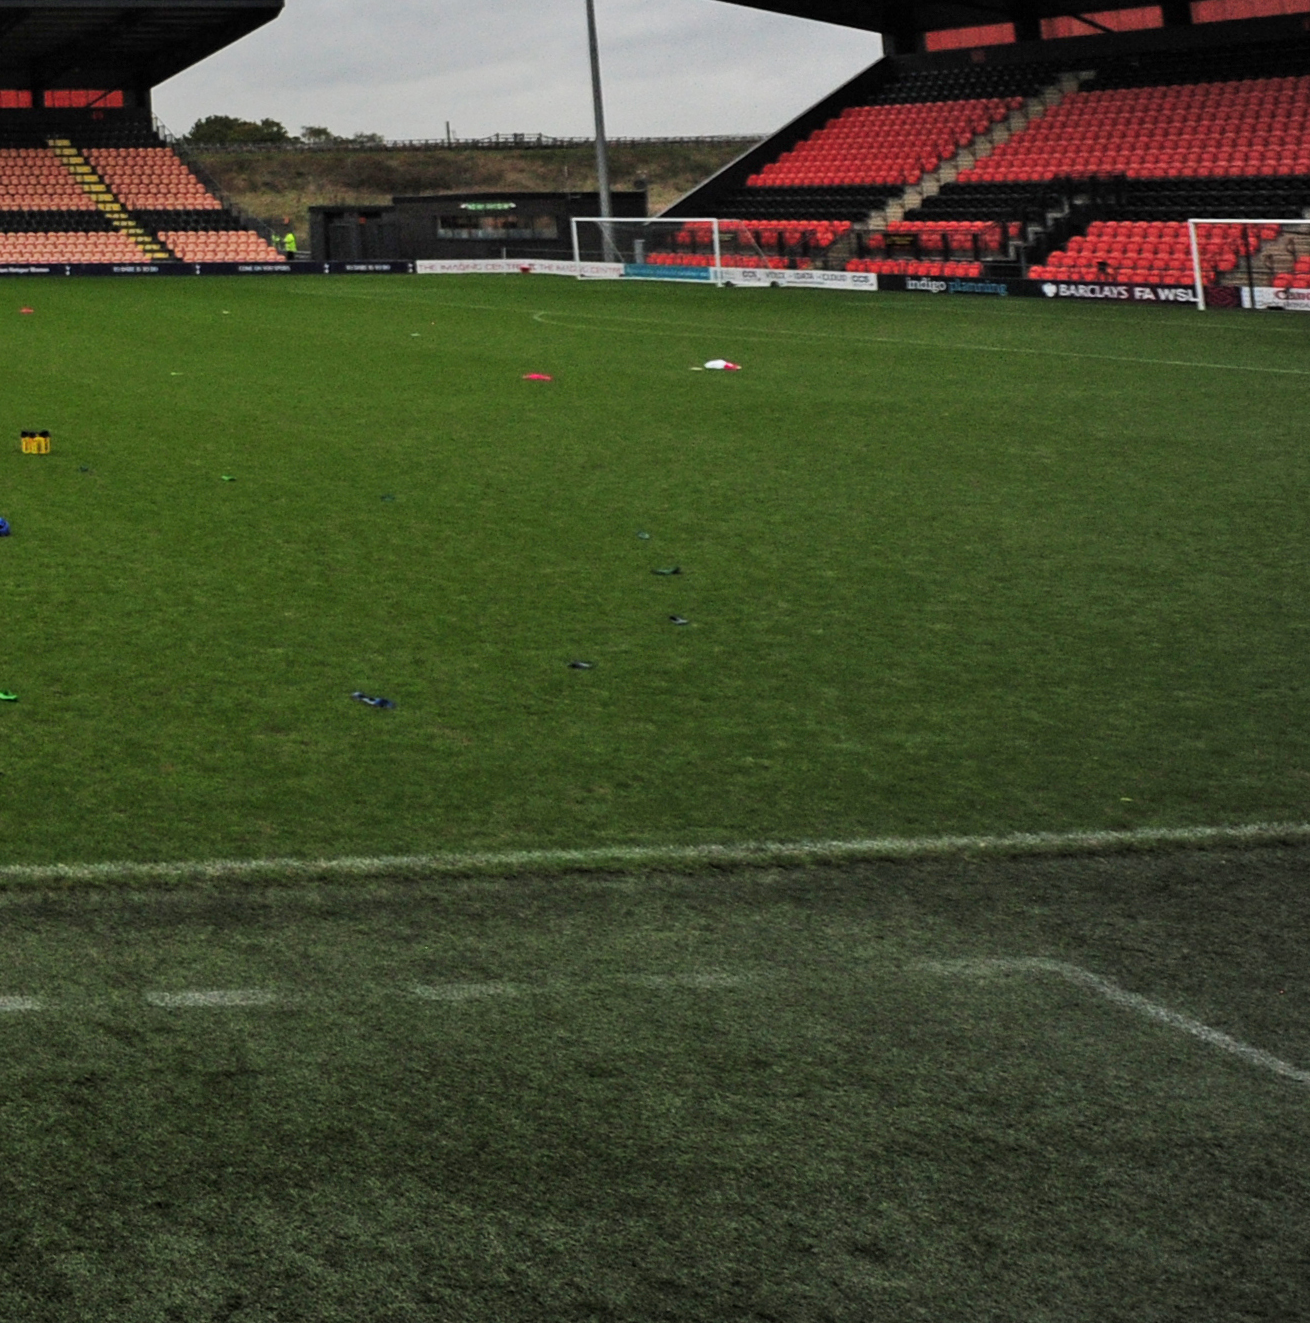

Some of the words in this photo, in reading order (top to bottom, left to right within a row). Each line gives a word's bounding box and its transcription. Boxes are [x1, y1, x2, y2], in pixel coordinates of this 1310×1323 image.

[906, 277, 946, 293] indigo
[1059, 284, 1129, 299] BARCLAYS
[1134, 287, 1156, 300] FA
[1157, 287, 1200, 302] WSL
